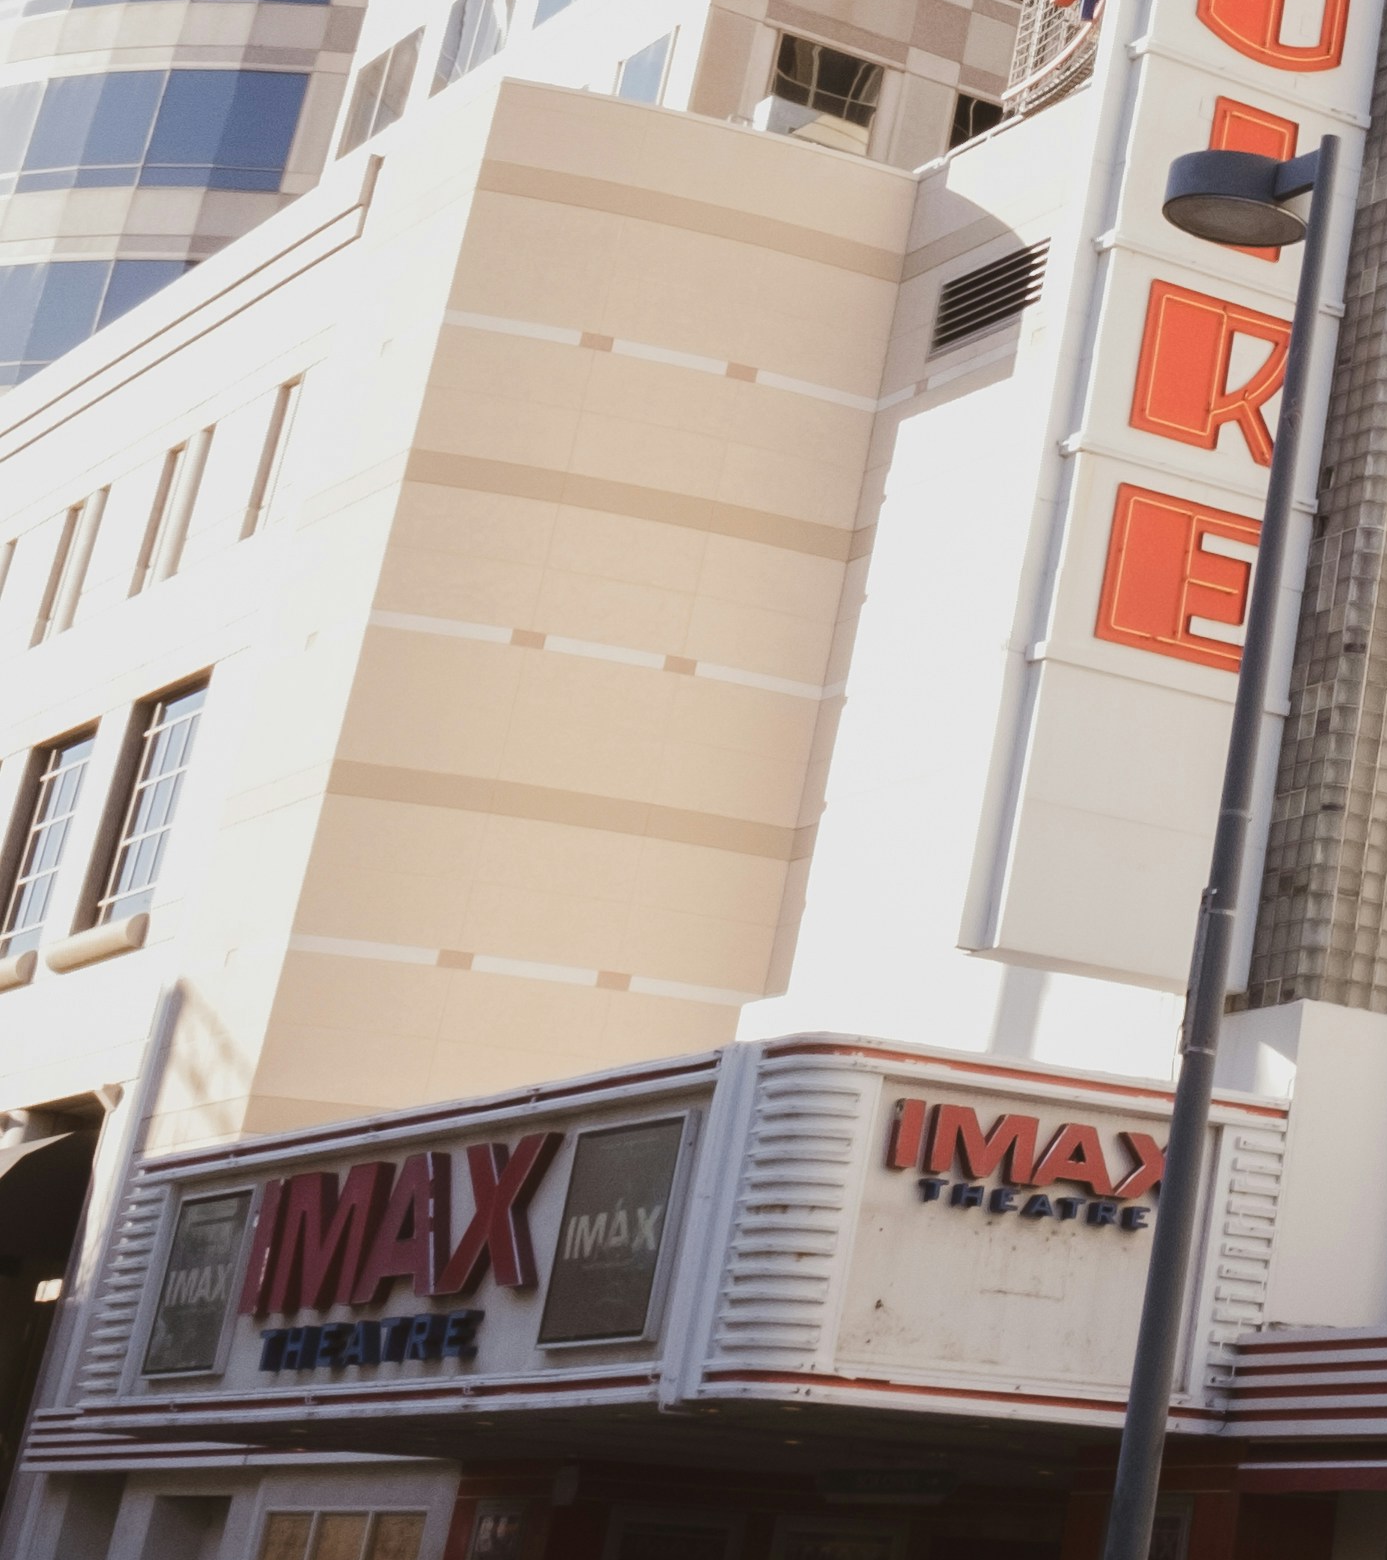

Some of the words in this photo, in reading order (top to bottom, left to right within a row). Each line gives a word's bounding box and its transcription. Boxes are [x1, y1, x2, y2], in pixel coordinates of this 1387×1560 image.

[238, 1132, 564, 1317] IMAX
[919, 1179, 1150, 1229] THEATRE
[564, 1205, 663, 1260] IMAX
[165, 1263, 234, 1306] IMAX
[259, 1310, 485, 1371] THEATRE
